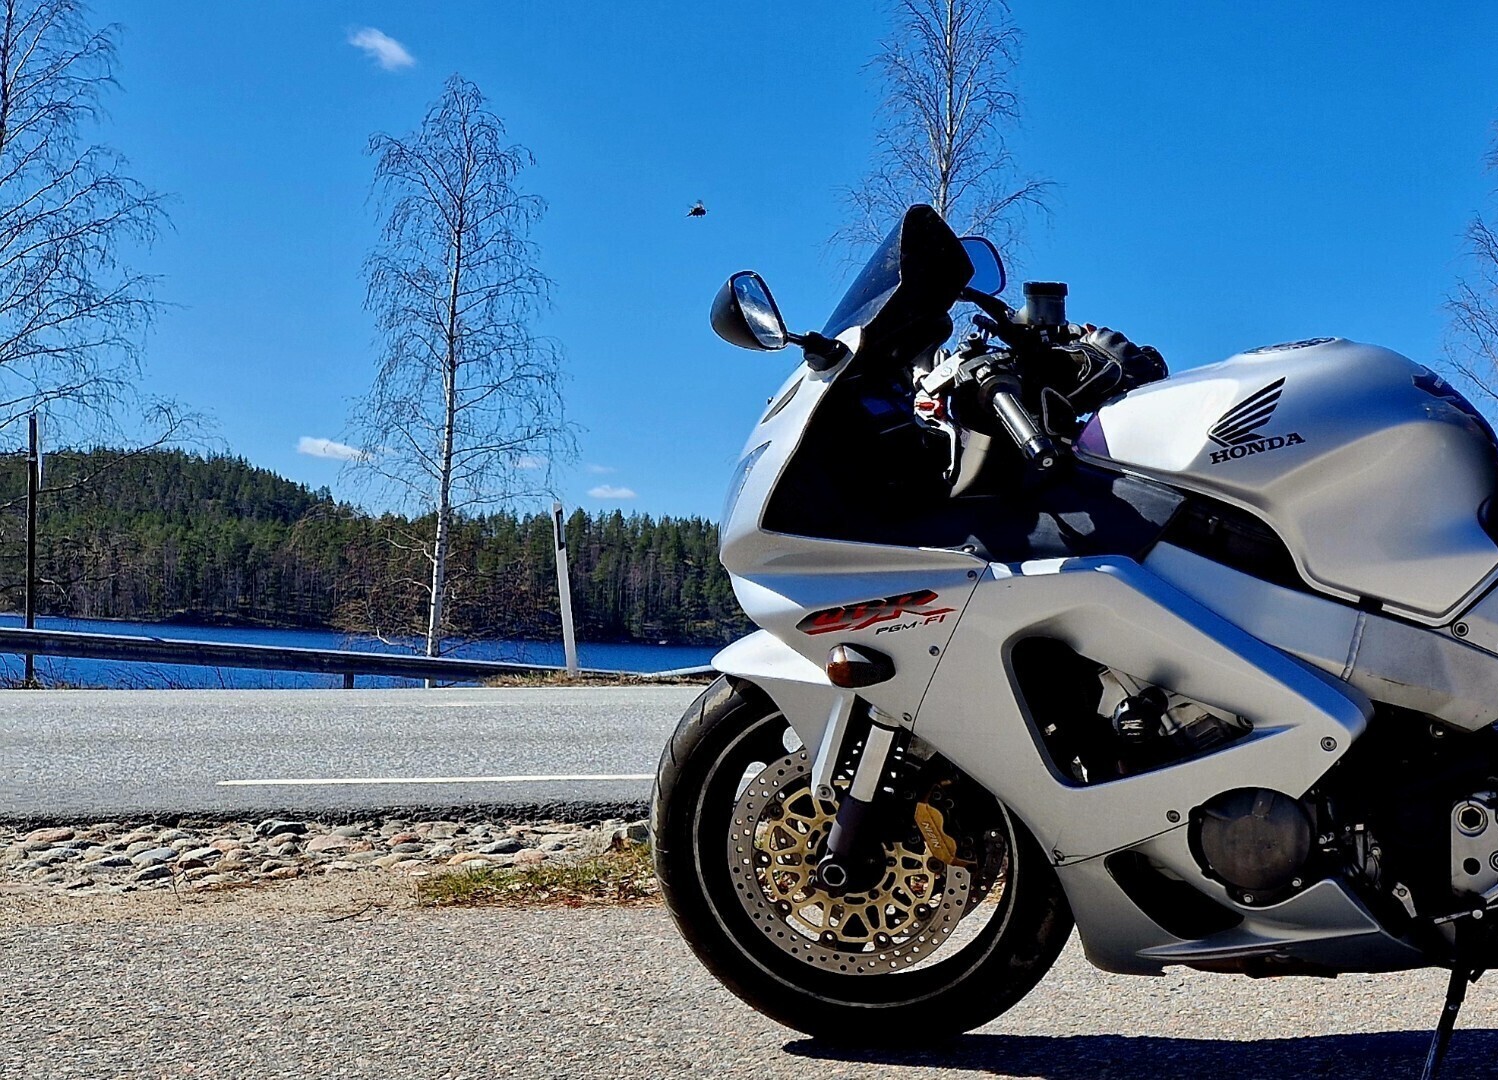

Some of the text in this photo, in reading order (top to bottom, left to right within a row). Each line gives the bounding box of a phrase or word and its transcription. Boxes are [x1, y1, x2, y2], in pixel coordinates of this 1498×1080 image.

[1209, 432, 1306, 464] HONDA
[796, 589, 957, 635] CBR
[875, 615, 946, 635] PGM-FI
